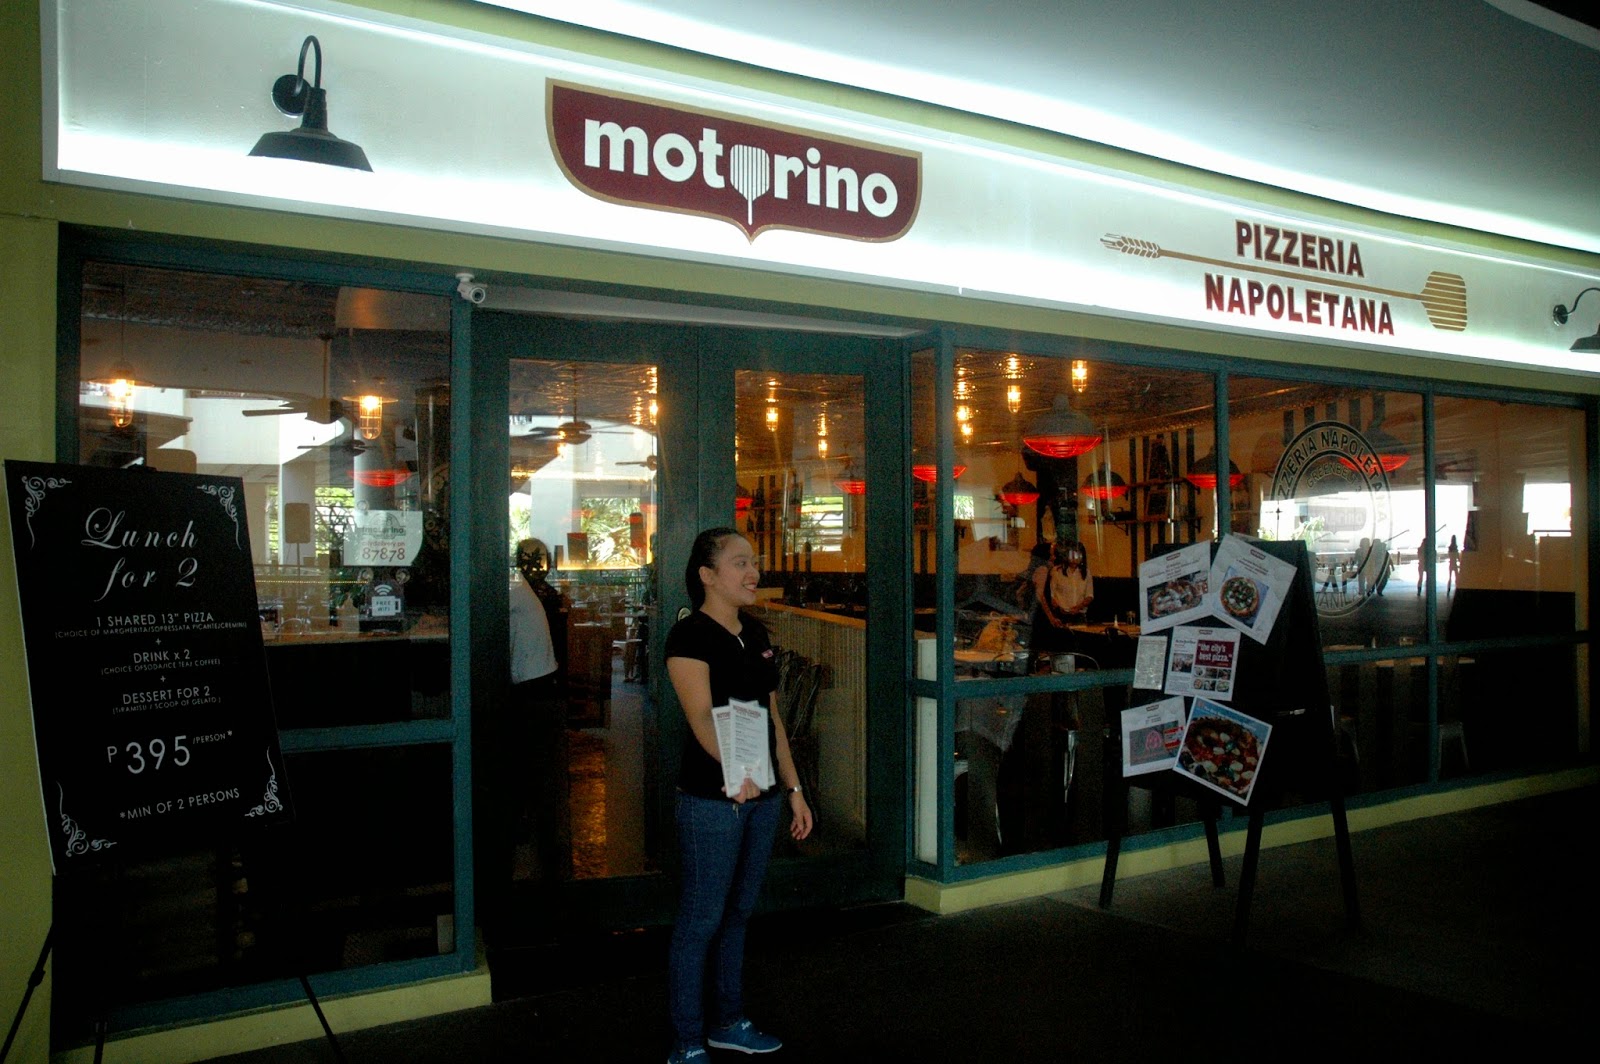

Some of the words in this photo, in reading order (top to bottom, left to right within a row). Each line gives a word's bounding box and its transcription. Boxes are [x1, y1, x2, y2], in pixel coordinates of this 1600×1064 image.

[1234, 219, 1365, 278] PIZZERIA
[1203, 272, 1395, 336] NAPOLETANA
[1306, 463, 1356, 488] GREENBELT
[81, 507, 198, 549] Lunch
[362, 547, 405, 562] 87878
[94, 557, 157, 602] for
[175, 557, 198, 587] 2
[96, 616, 101, 628] 1
[107, 614, 156, 628] SHARED
[161, 613, 179, 624] 13"
[184, 611, 214, 623] PIZZA
[90, 629, 100, 637] OF
[133, 650, 170, 664] DRINK
[183, 648, 191, 660] 2
[122, 689, 173, 705] DESSERT
[176, 686, 200, 699] FOR
[203, 685, 211, 697] 2
[106, 745, 118, 764] P
[126, 735, 190, 774] 395
[156, 800, 173, 814] OF
[177, 798, 185, 810] 2
[188, 787, 240, 807] PERSONS
